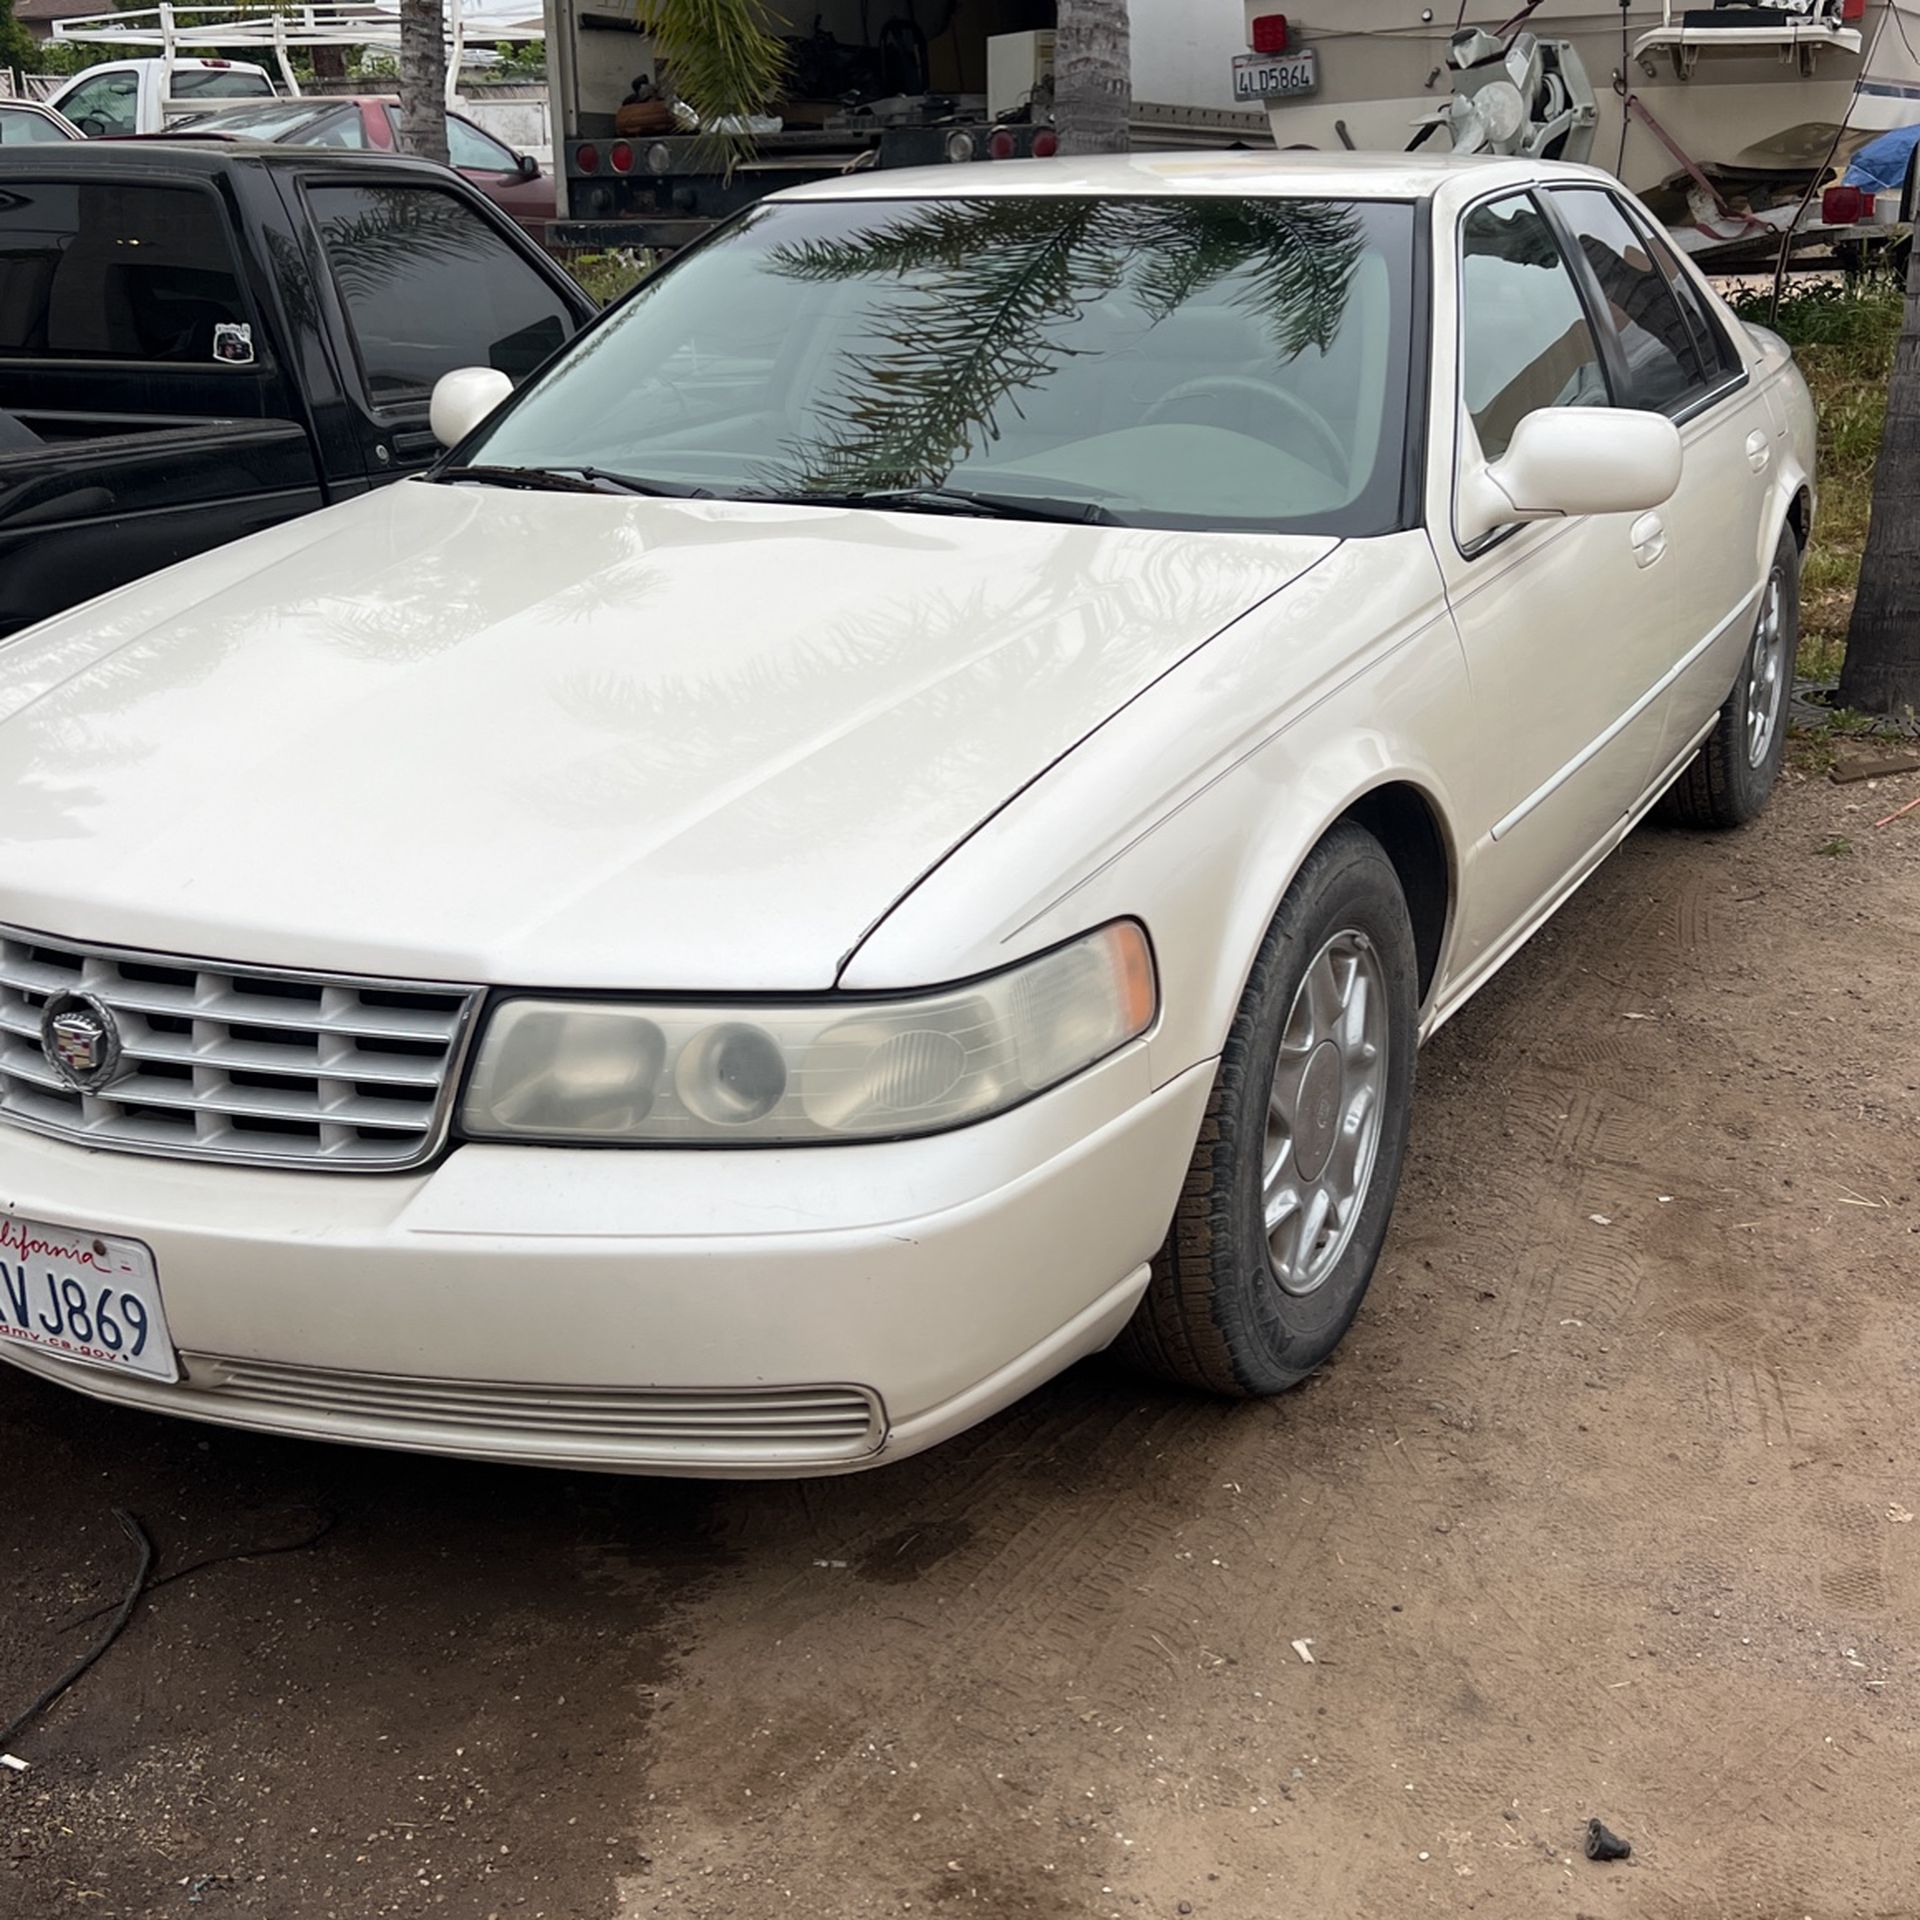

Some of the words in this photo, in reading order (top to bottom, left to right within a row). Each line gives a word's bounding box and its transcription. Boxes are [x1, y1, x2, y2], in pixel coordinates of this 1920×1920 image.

[1239, 64, 1310, 93] 4LD5864
[0, 1221, 112, 1273] lifornia
[0, 1260, 148, 1357] VJ869
